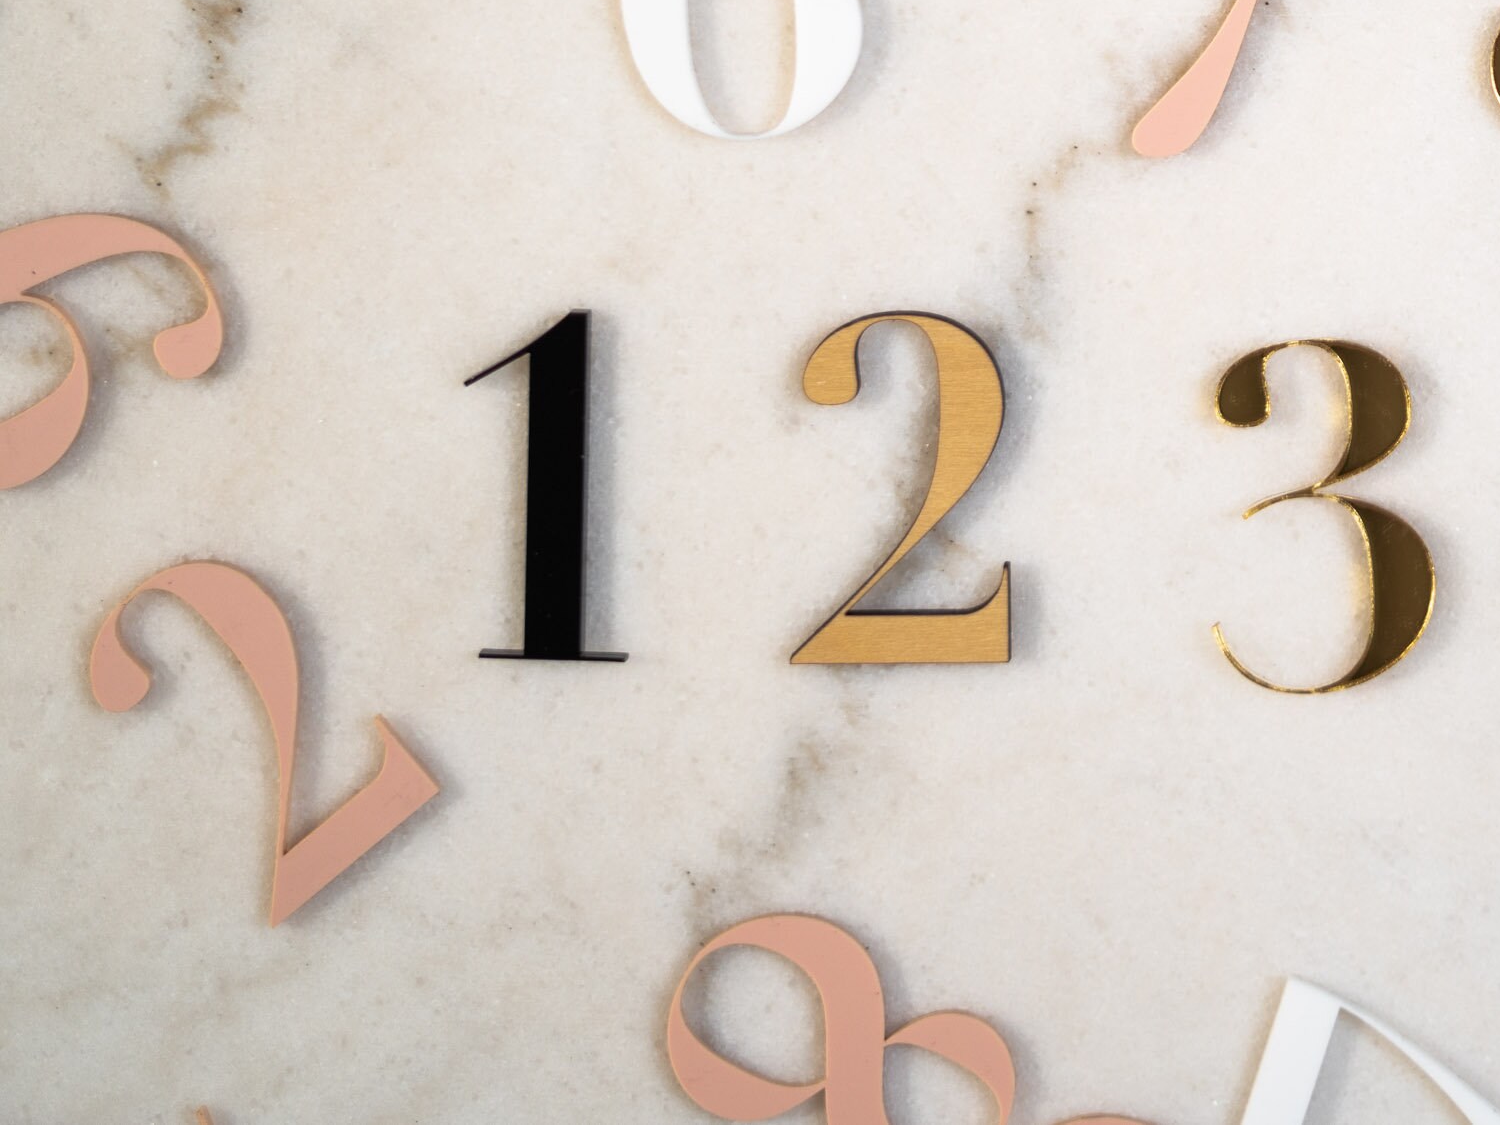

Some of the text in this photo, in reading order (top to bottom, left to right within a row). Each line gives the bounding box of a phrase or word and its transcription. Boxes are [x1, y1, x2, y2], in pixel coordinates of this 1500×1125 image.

[464, 309, 629, 663] 1
[790, 312, 1014, 665] 2
[1210, 338, 1437, 695] 3
[90, 560, 439, 928] 2
